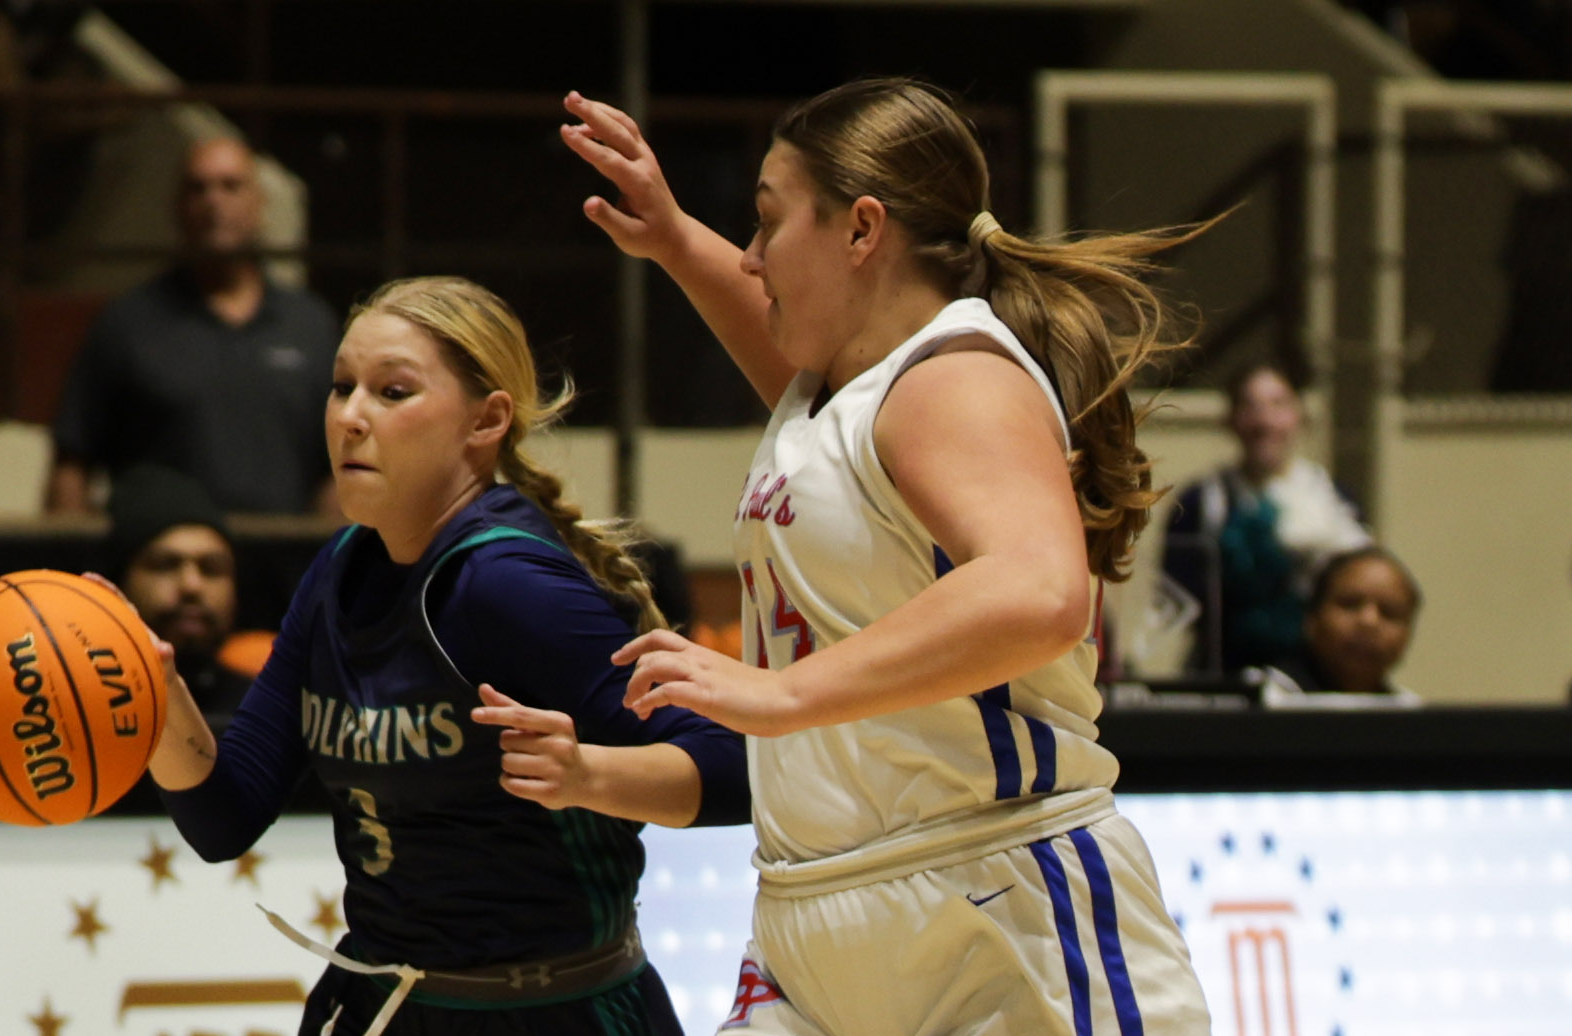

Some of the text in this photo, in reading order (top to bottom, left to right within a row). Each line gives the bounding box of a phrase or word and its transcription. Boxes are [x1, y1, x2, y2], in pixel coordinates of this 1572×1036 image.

[5, 632, 76, 801] Wilson
[86, 647, 139, 738] EVO
[348, 787, 395, 876] 3
